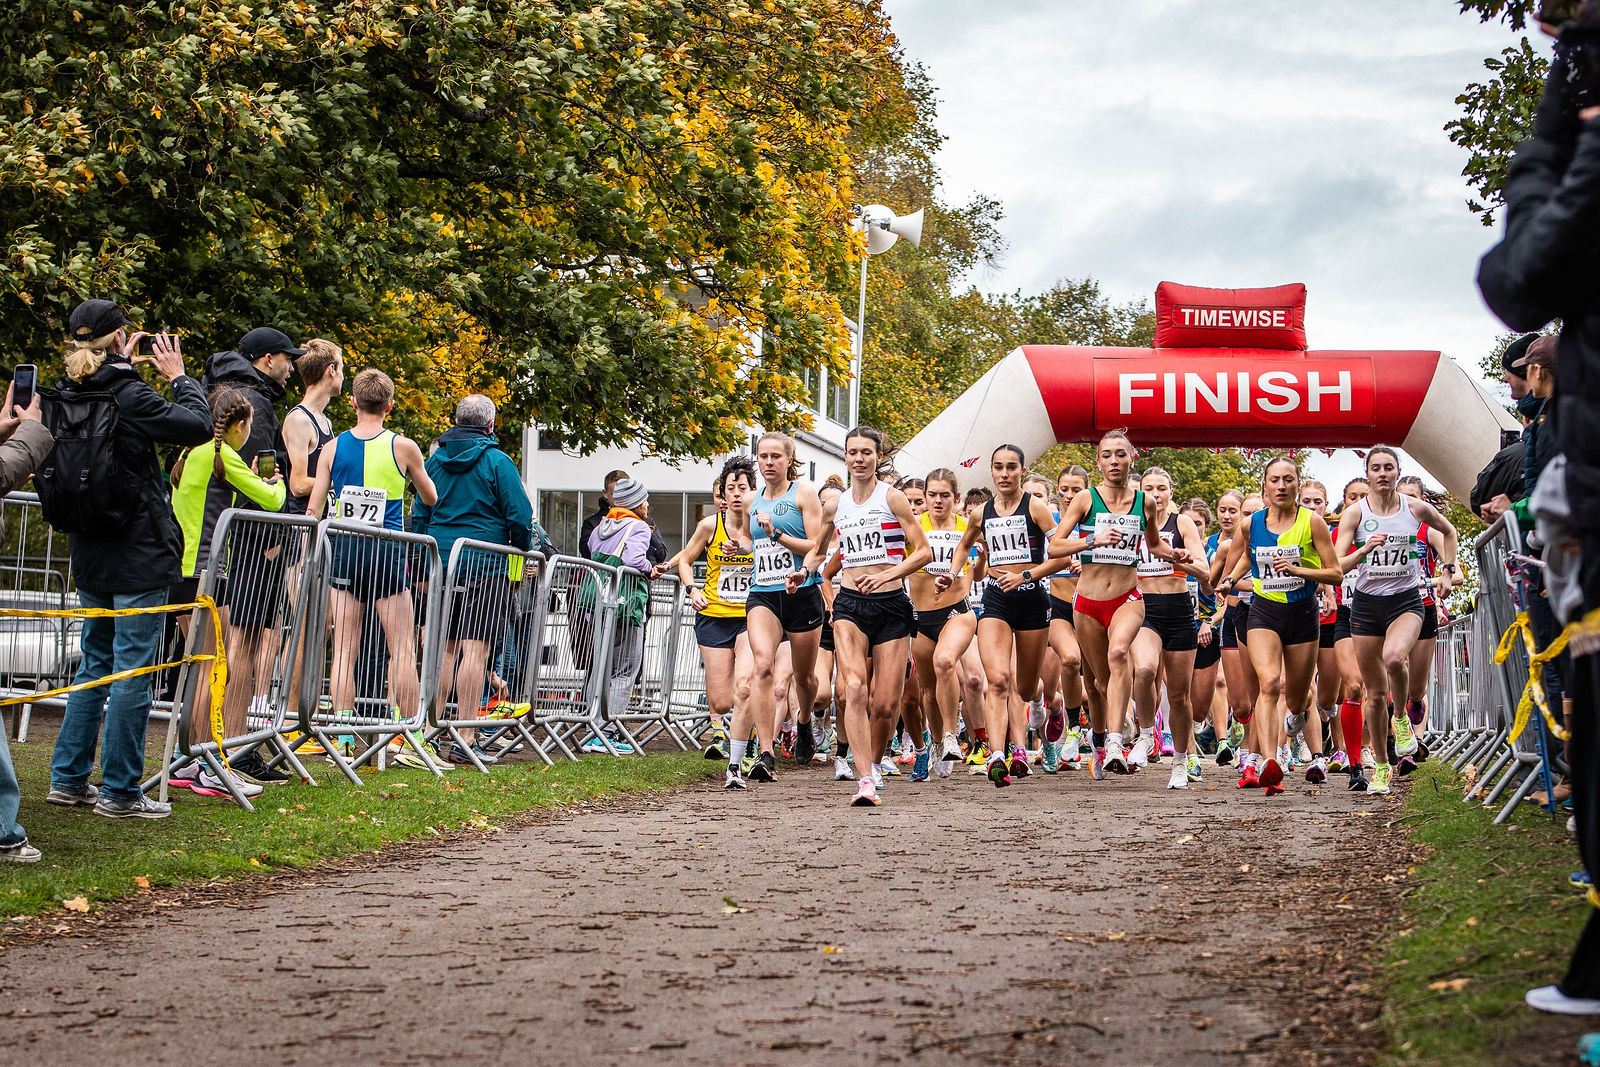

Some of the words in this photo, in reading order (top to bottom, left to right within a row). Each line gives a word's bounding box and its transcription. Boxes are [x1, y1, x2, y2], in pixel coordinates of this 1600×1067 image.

[1181, 308, 1286, 328] TIMEWISE
[1119, 370, 1352, 415] FINISH
[344, 502, 354, 518] B
[360, 503, 379, 522] 72
[846, 531, 883, 554] A142
[991, 532, 1028, 552] A114
[714, 554, 754, 563] STOCKPO
[758, 551, 793, 574] A163
[1371, 548, 1409, 567] A176
[757, 574, 789, 583] BIRMINGHA
[1369, 570, 1409, 578] BIRMINGHAM
[1262, 580, 1304, 590] BIRMINGHAM
